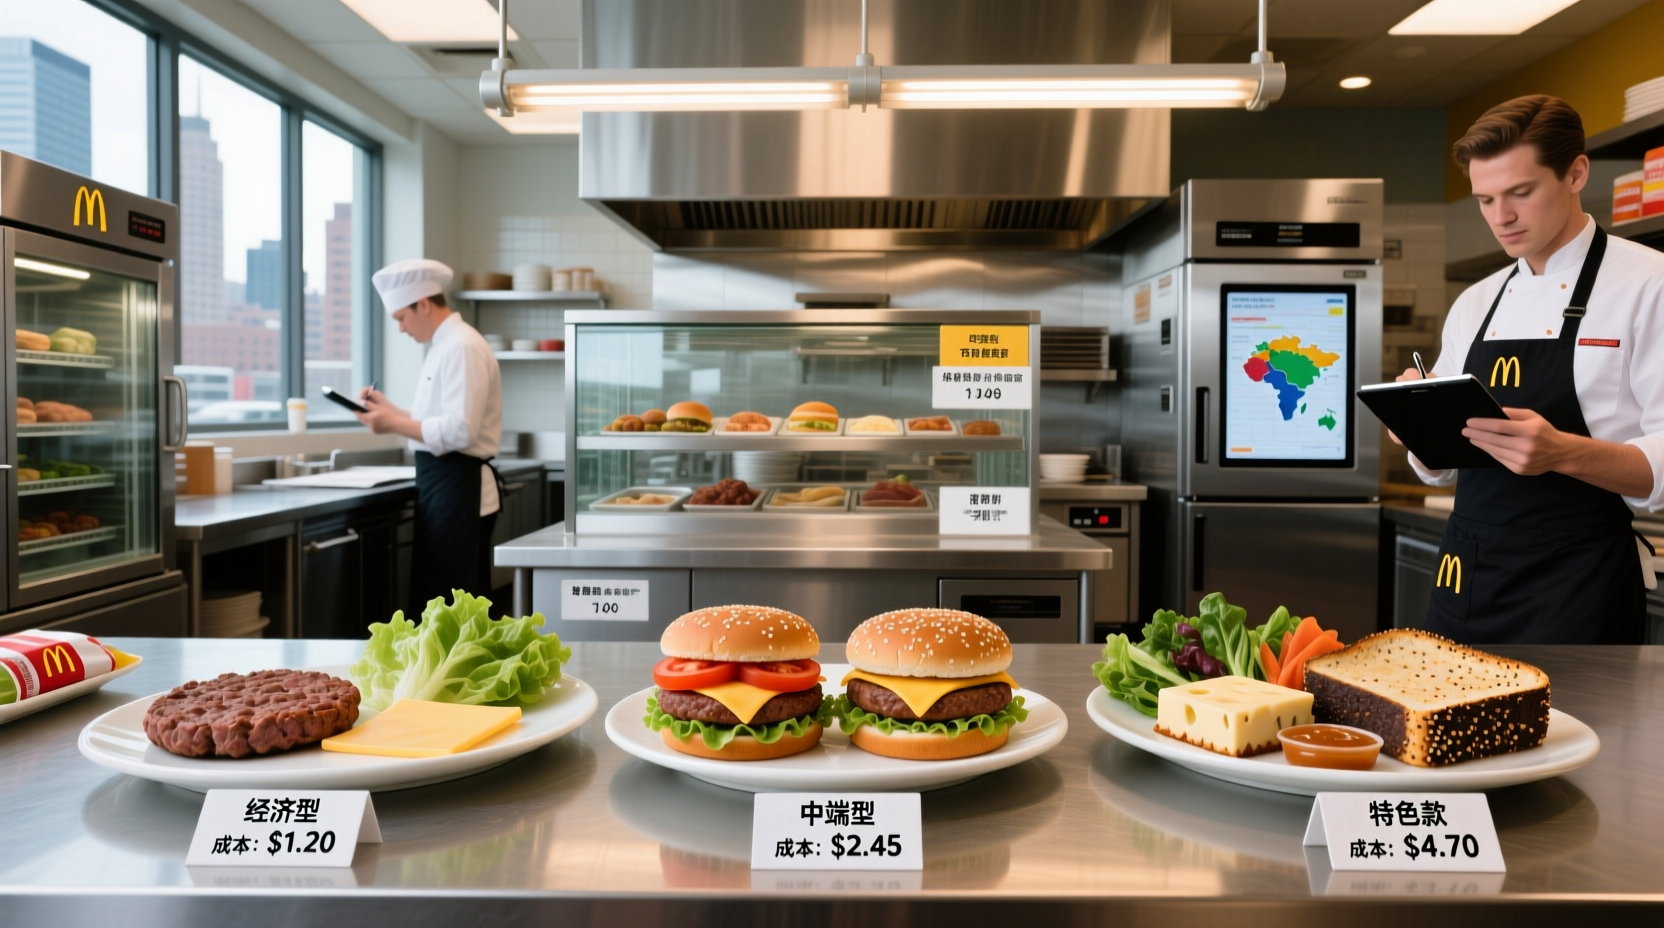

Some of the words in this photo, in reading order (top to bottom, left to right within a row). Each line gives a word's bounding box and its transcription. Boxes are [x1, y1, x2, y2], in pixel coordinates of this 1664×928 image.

[243, 797, 321, 824] 经济型
[800, 799, 875, 827] 中端型
[1369, 800, 1448, 827] 特色款
[266, 830, 336, 857] $1.20
[831, 832, 902, 861] $2.45
[1403, 832, 1480, 862] $4.70
